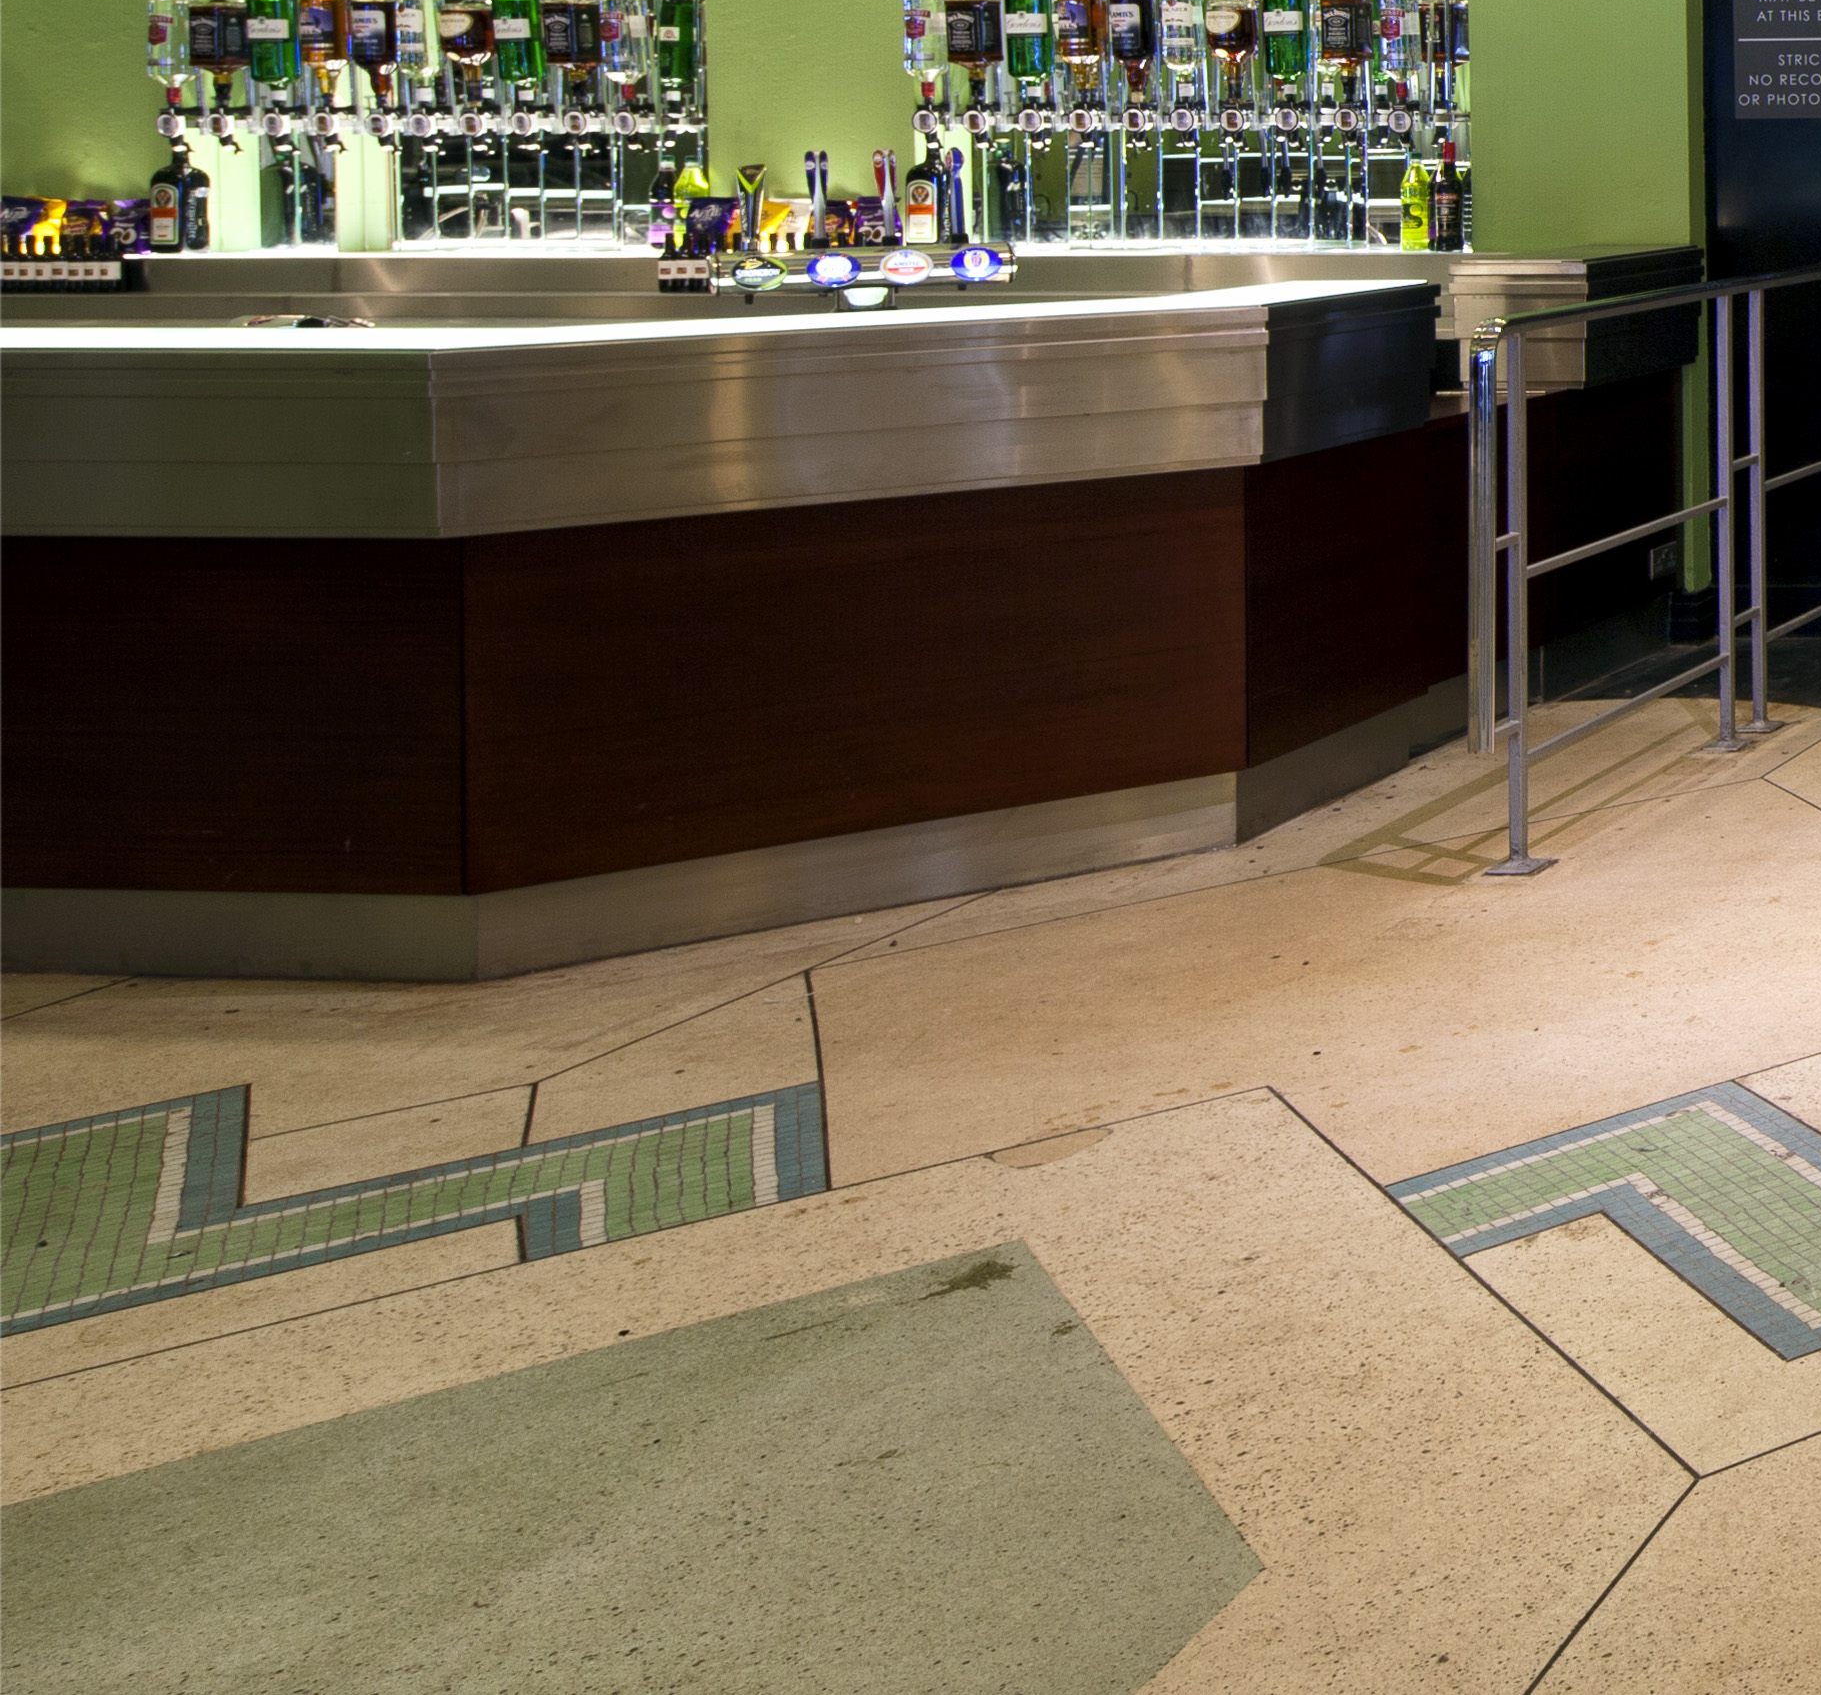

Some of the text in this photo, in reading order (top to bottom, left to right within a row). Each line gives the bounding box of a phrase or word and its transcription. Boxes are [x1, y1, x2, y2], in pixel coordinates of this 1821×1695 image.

[1756, 10, 1774, 22] AT
[1780, 10, 1811, 22] THIS
[1749, 74, 1773, 87] NO
[1738, 93, 1760, 106] OR
